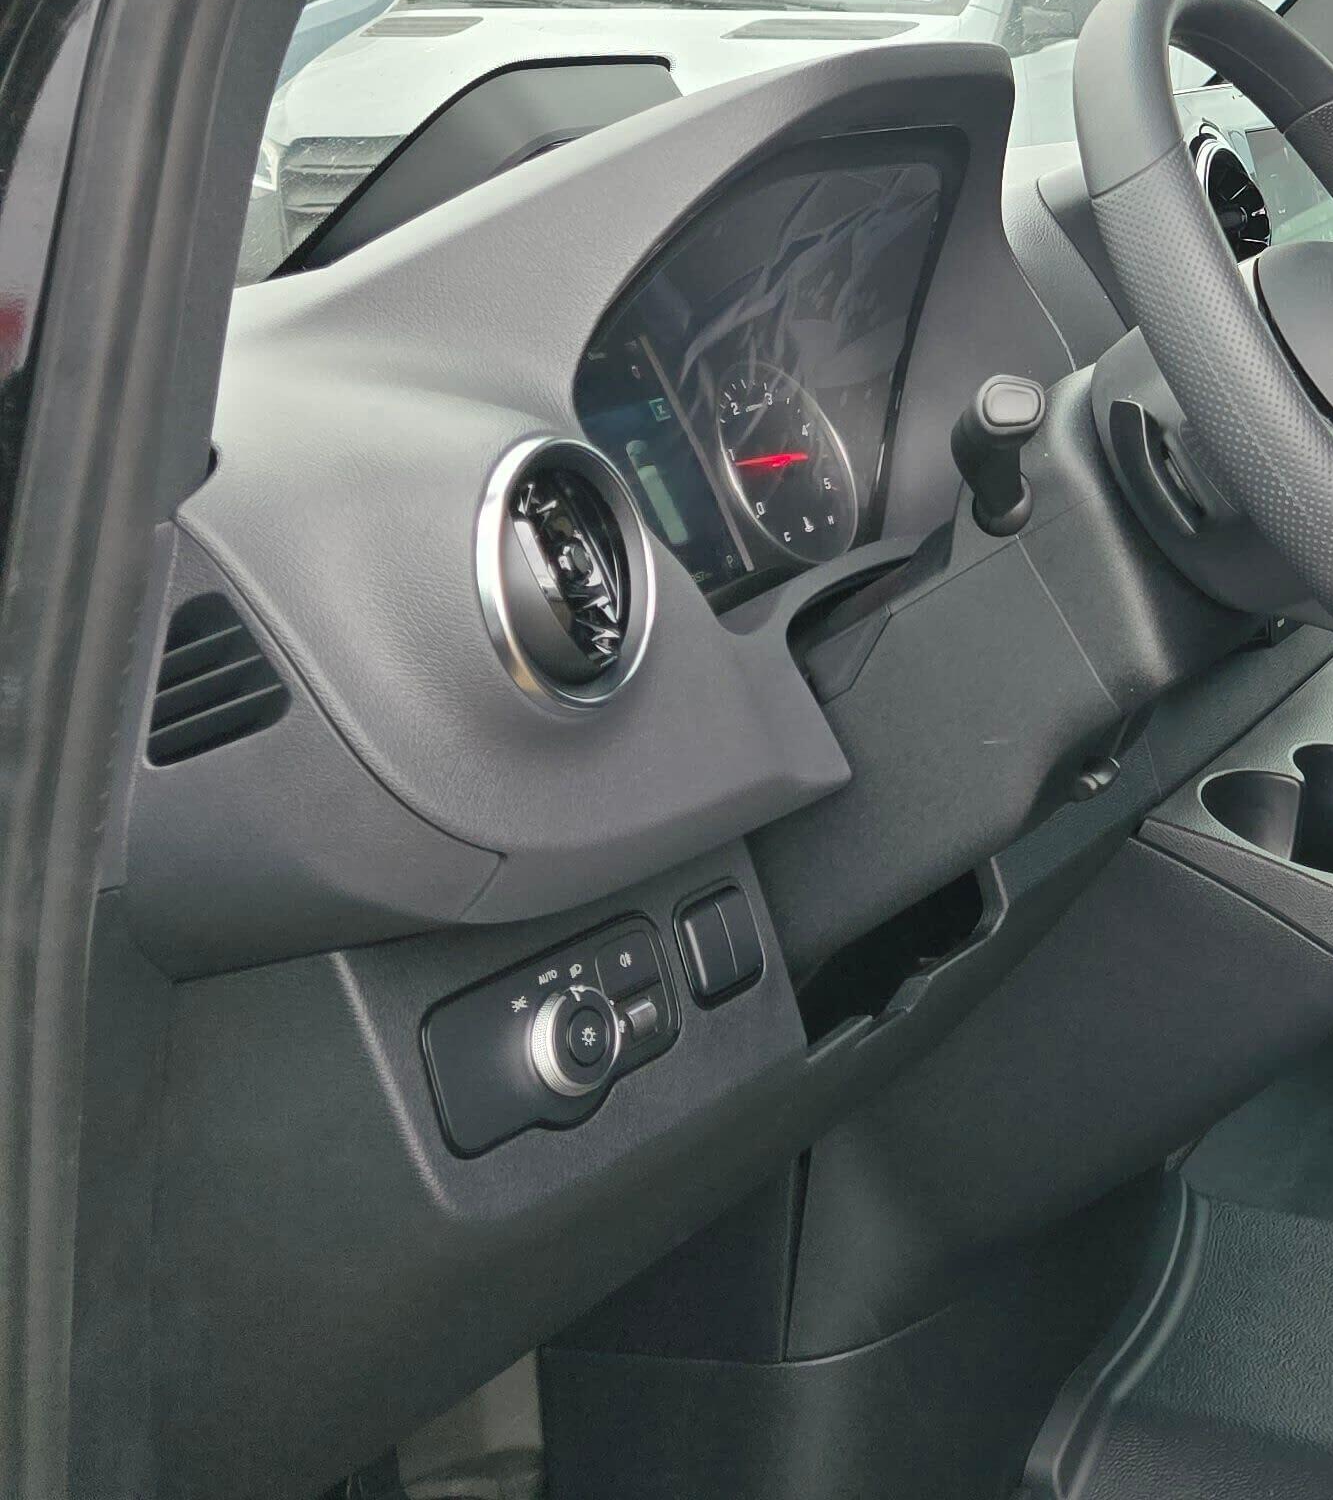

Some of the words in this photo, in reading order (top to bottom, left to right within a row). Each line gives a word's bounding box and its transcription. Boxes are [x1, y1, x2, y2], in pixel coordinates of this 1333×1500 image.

[764, 392, 773, 406] 3
[730, 402, 740, 415] 2
[823, 477, 832, 490] 5
[755, 501, 766, 516] 0
[783, 531, 791, 542] C
[538, 969, 558, 985] AUTO
